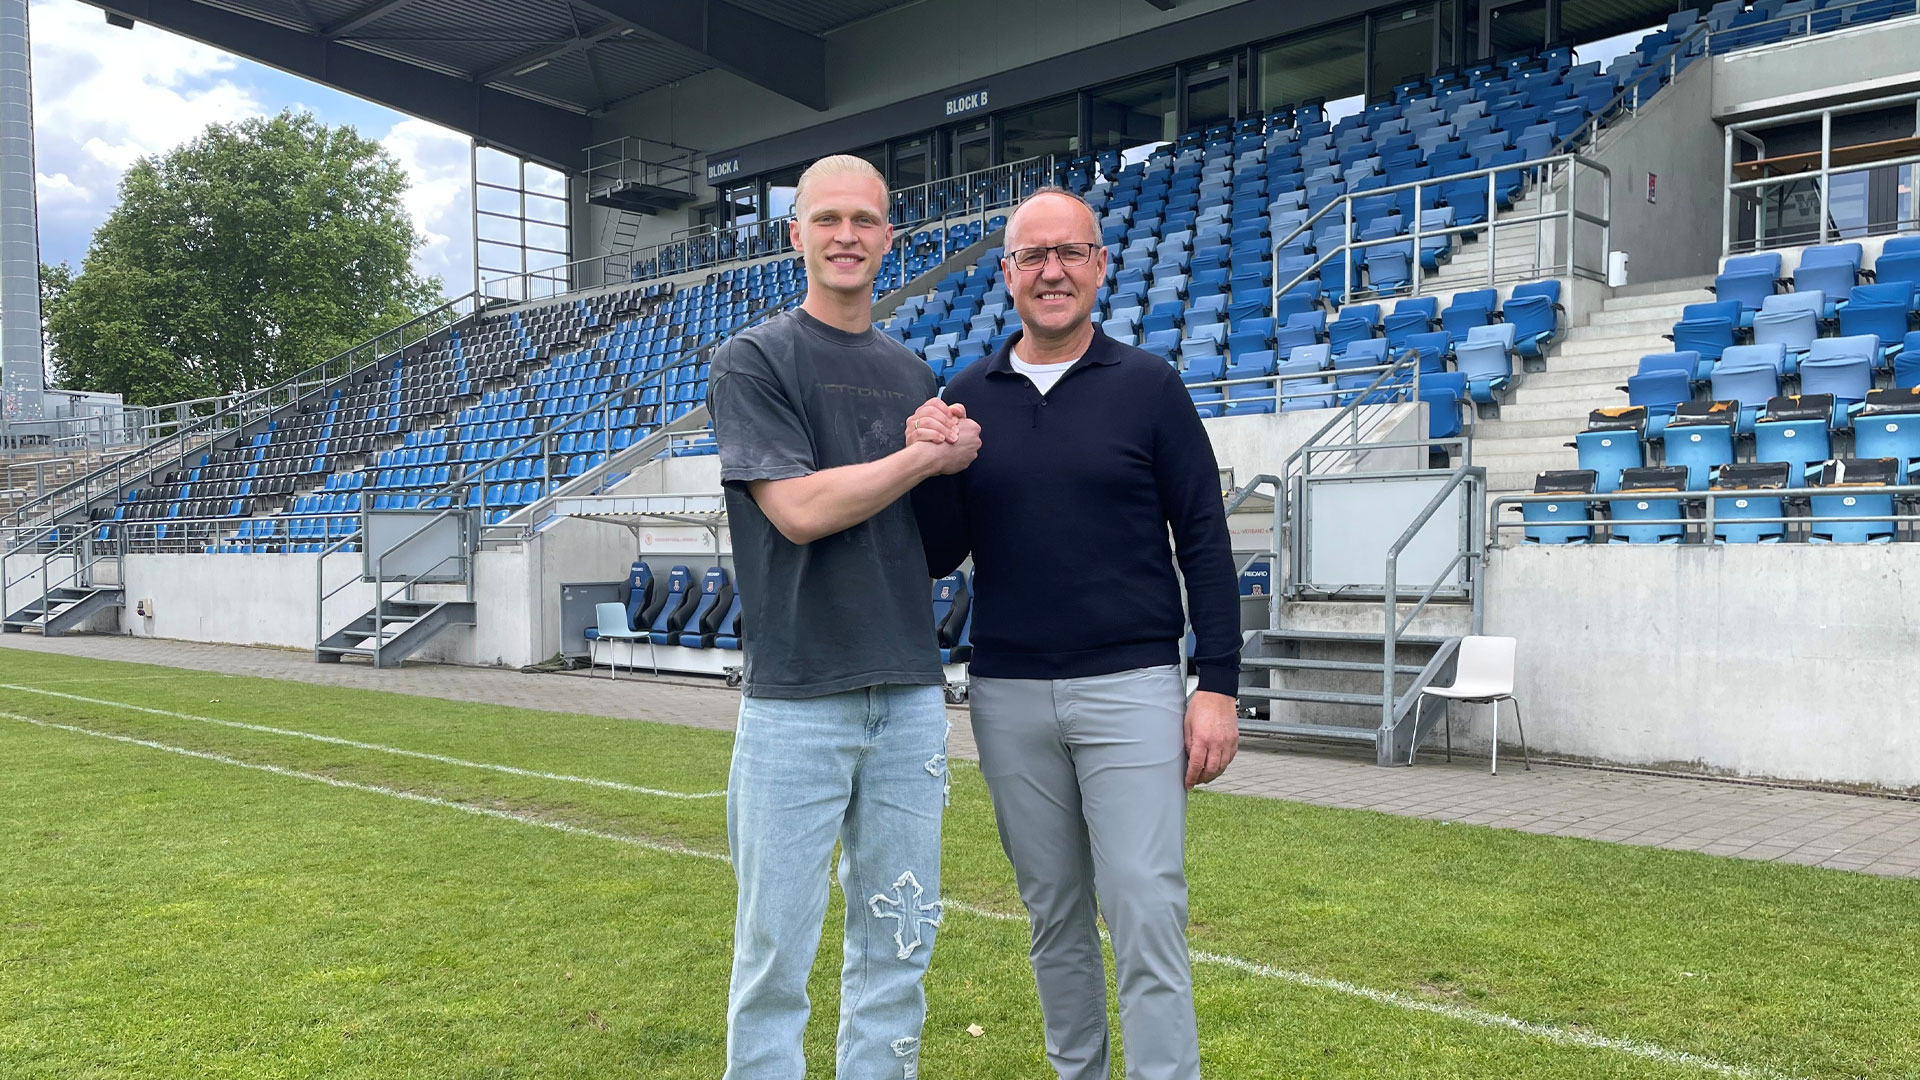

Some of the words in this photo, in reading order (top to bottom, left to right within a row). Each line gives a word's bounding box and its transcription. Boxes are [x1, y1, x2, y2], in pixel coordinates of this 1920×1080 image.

[946, 93, 979, 116] BLOCK
[980, 91, 988, 106] B
[708, 161, 732, 179] BLOCK
[732, 159, 739, 172] A
